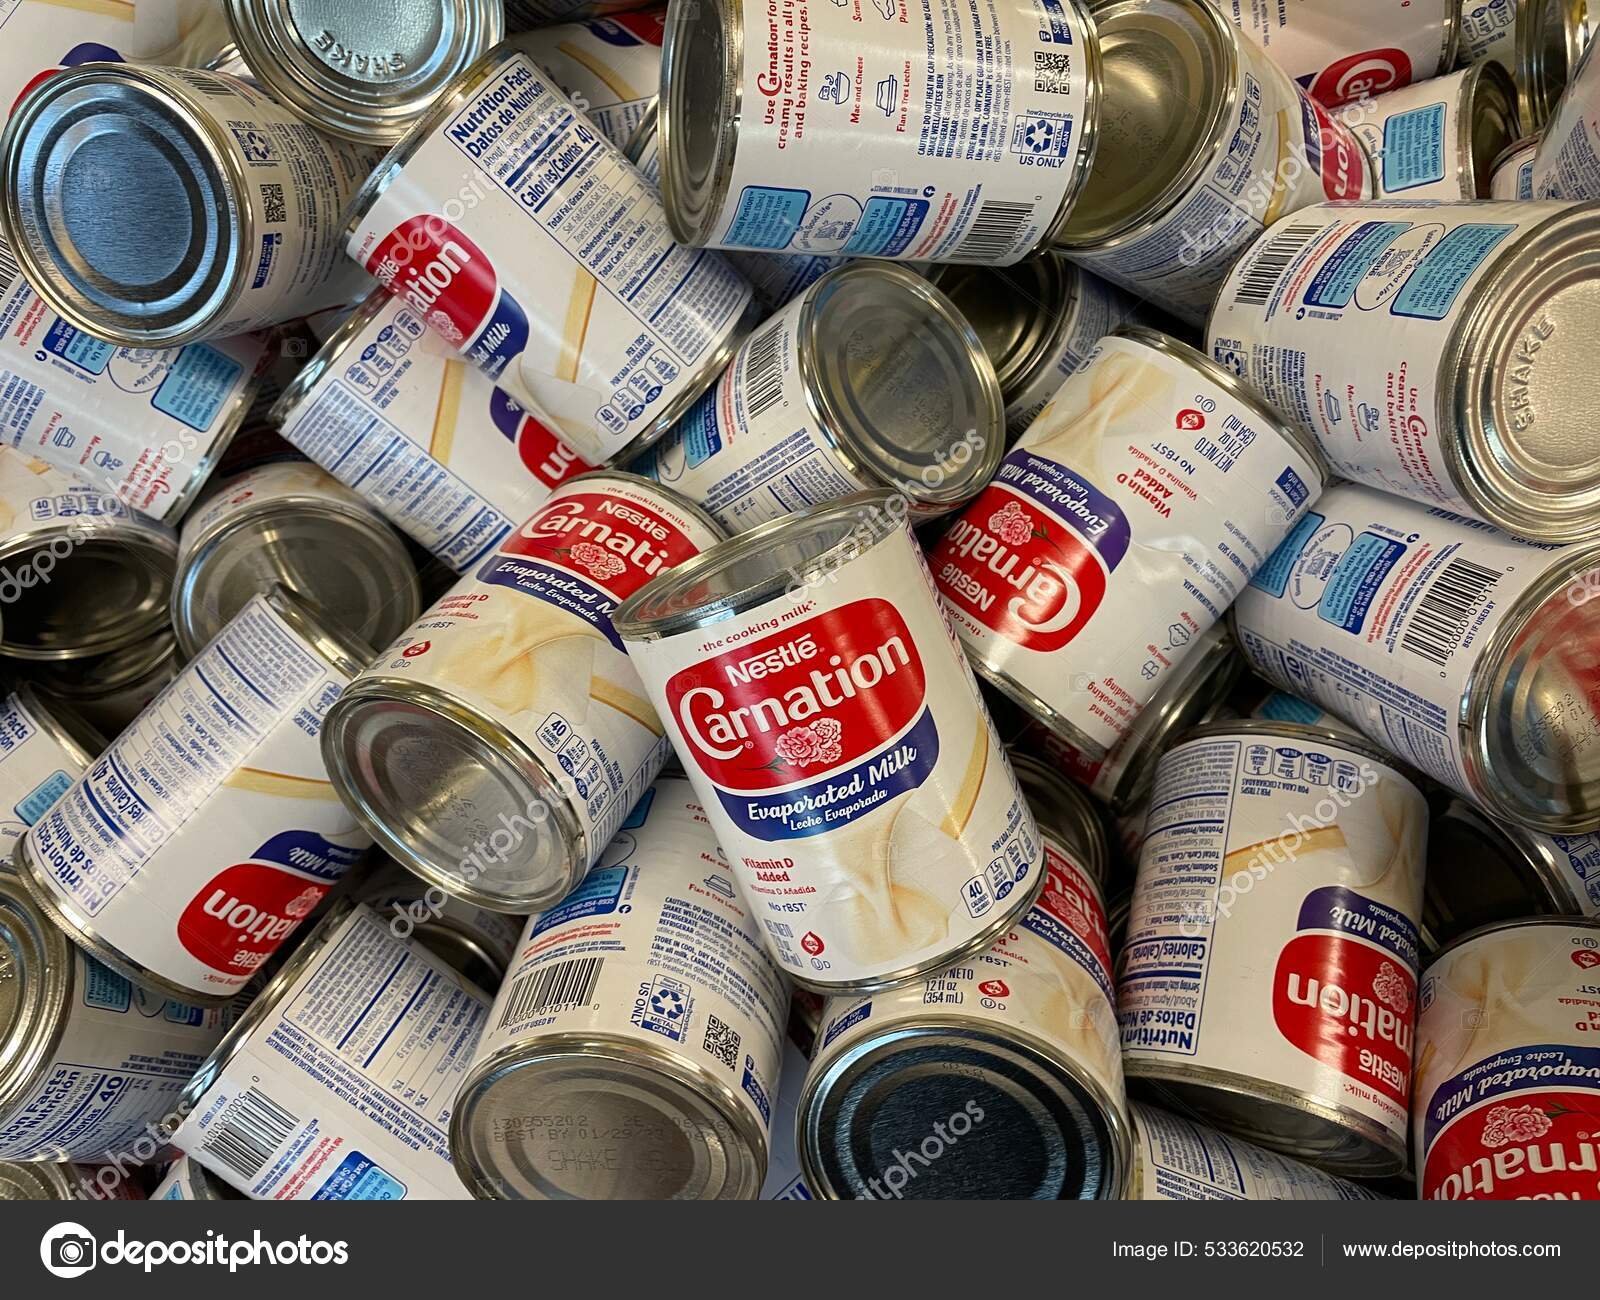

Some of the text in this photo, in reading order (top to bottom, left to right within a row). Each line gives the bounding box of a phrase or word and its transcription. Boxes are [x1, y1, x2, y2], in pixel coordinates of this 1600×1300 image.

[778, 11, 794, 149] creamy results in all
[795, 6, 811, 139] and baking recipes,
[903, 60, 911, 87] Leches
[927, 60, 935, 74] CAN
[850, 56, 864, 124] Mac and Cheese
[902, 88, 910, 105] Tres
[926, 84, 934, 100] HEAT
[975, 80, 984, 100] PLACE
[451, 66, 533, 144] Nutrition Facts
[466, 122, 504, 158] Datos
[499, 108, 514, 126] de
[510, 81, 546, 119] Nutrición
[764, 100, 776, 125] Use
[927, 137, 937, 157] SHAKE
[936, 74, 945, 93] BIEN
[974, 101, 982, 114] DRY
[575, 124, 594, 145] 40
[896, 115, 907, 133] Flan
[1054, 127, 1064, 150] METAL
[966, 141, 975, 160] STORE
[1061, 131, 1071, 147] CAN
[1019, 155, 1065, 168] US ONLY
[547, 214, 562, 230] Total
[405, 240, 471, 313] ation
[485, 321, 511, 354] Milk
[1396, 361, 1408, 414] creamy
[1509, 315, 1558, 432] SHAKE
[1386, 372, 1400, 445] and baking
[1409, 387, 1419, 412] Use
[601, 407, 614, 422] 40
[1237, 424, 1258, 448] (354
[1400, 416, 1415, 458] results
[1179, 459, 1196, 475] No
[1194, 437, 1235, 473] NET/NETO
[1063, 478, 1089, 498] Leche
[1116, 473, 1173, 519] Vitamin D
[1133, 468, 1174, 499] Added
[1165, 472, 1198, 501] Vitamina
[34, 499, 49, 509] 40
[624, 491, 664, 515] cooking
[1023, 472, 1110, 536] Evaporated
[598, 499, 670, 541] Nestlé
[521, 501, 676, 579] Carnati
[496, 561, 597, 605] Evaporated
[938, 563, 996, 612] Nestlé
[948, 520, 1082, 633] Carnatio
[517, 577, 600, 622] Leche Evaporada
[703, 602, 813, 652] the cooking milk
[725, 633, 818, 688] Nestlé
[680, 635, 911, 760] Carnation
[5, 711, 29, 740] Facts
[551, 720, 568, 737] 40
[92, 760, 109, 781] 40
[748, 746, 918, 824] Evaporated Milk
[790, 789, 888, 832] Leche Evaporada
[37, 821, 104, 911] Nutrition Facts
[70, 845, 84, 863] de
[742, 857, 795, 871] Vitamin D
[756, 871, 791, 882] Added
[783, 883, 817, 895] Añadida
[969, 880, 983, 898] 40
[768, 902, 782, 912] No
[1328, 906, 1377, 938] Milk
[923, 992, 964, 1005] (354 mL)
[926, 980, 934, 992] 12
[945, 982, 957, 991] oz
[540, 1002, 600, 1017] 01011 0
[630, 982, 651, 1028] US ONLY
[1156, 1009, 1196, 1030] Datos
[1287, 971, 1411, 1055] nation
[650, 1016, 676, 1029] METAL
[652, 1023, 672, 1037] CAN
[1463, 1050, 1566, 1082] Leche Evaporada
[27, 1071, 81, 1132] Nutrición
[29, 1069, 68, 1112] Facts
[100, 1076, 124, 1102] 40
[1436, 1058, 1600, 1122] vaporated Milk
